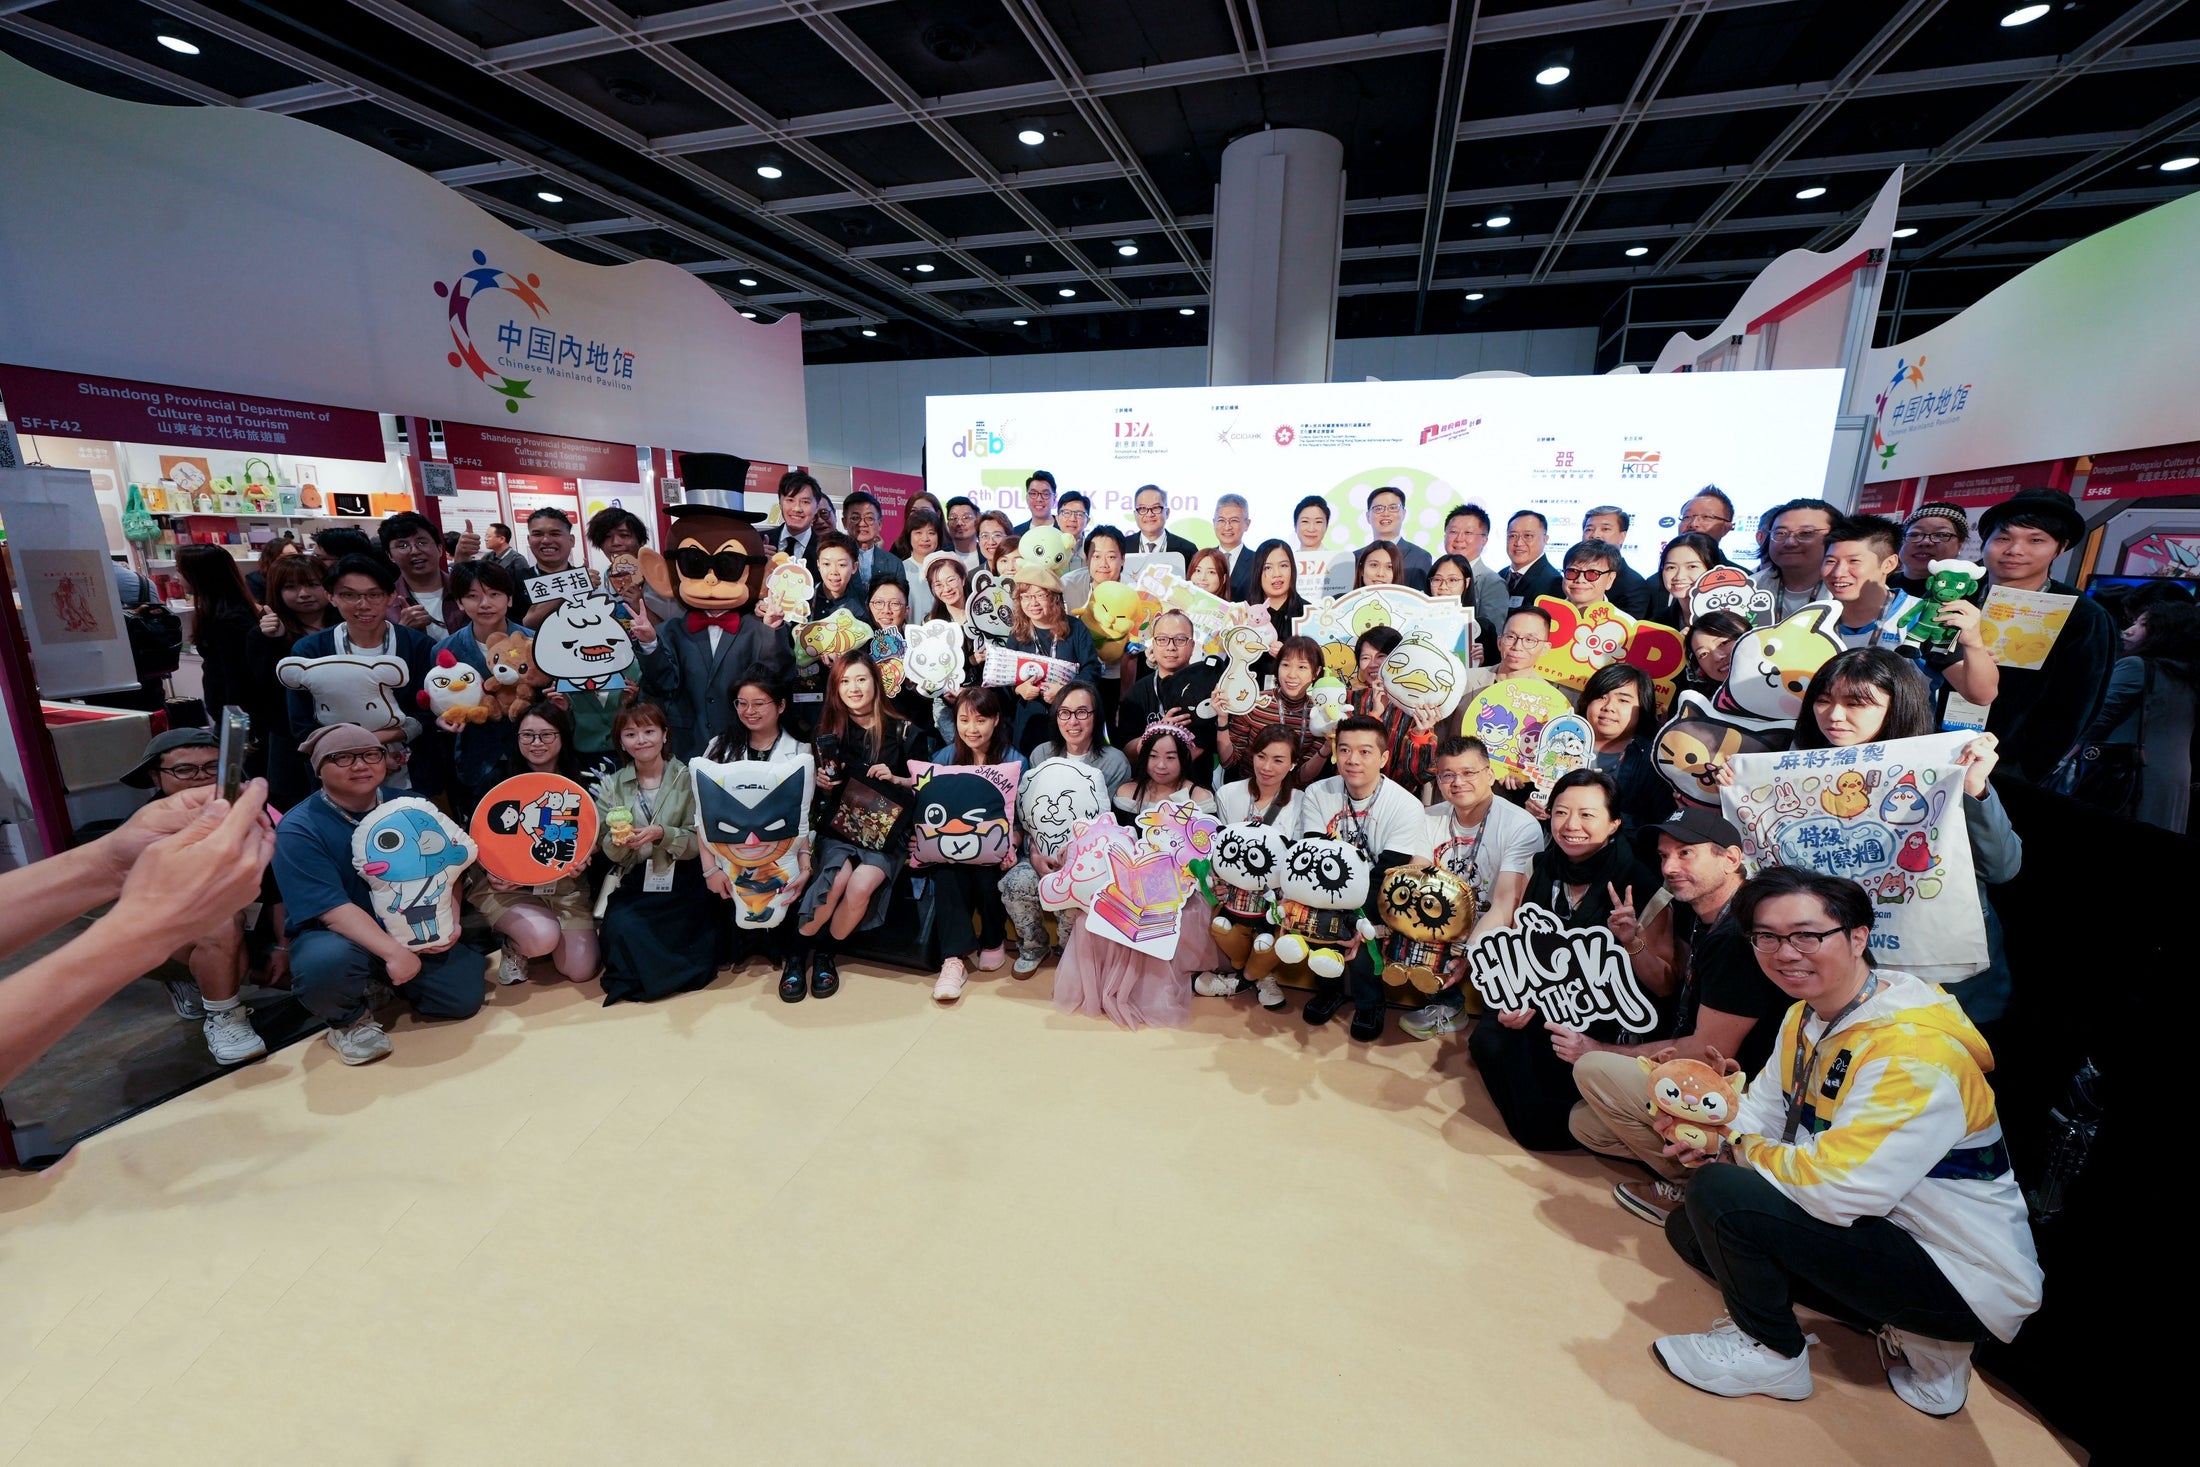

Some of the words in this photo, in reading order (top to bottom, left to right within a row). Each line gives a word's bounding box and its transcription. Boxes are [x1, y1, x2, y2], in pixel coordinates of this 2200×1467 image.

[497, 356, 542, 373] Chinese
[546, 366, 592, 383] Mainland
[596, 376, 632, 391] Pavilion
[78, 383, 161, 404] Shandong
[165, 393, 236, 411] Provincial
[239, 401, 316, 421] Department
[317, 412, 330, 422] of
[21, 416, 82, 432] 5F-F42
[147, 406, 203, 422] Culture
[206, 414, 232, 425] and
[235, 415, 289, 430] Tourism
[481, 432, 522, 446] Shandong
[523, 437, 560, 449] Provincial
[561, 441, 602, 454] Department
[514, 447, 543, 457] Culture
[544, 450, 558, 458] and
[560, 452, 588, 461] Tourism
[453, 456, 482, 467] 5F-F42
[1621, 463, 1659, 473] HKTDC
[2163, 457, 2194, 467] Culture
[967, 490, 991, 508] 6th
[531, 572, 589, 598] 金手指
[1773, 743, 1886, 771] 麻籽繪製
[975, 765, 1015, 794] SAMSAM
[1797, 825, 1845, 849] 特級
[1873, 908, 1892, 919] eam
